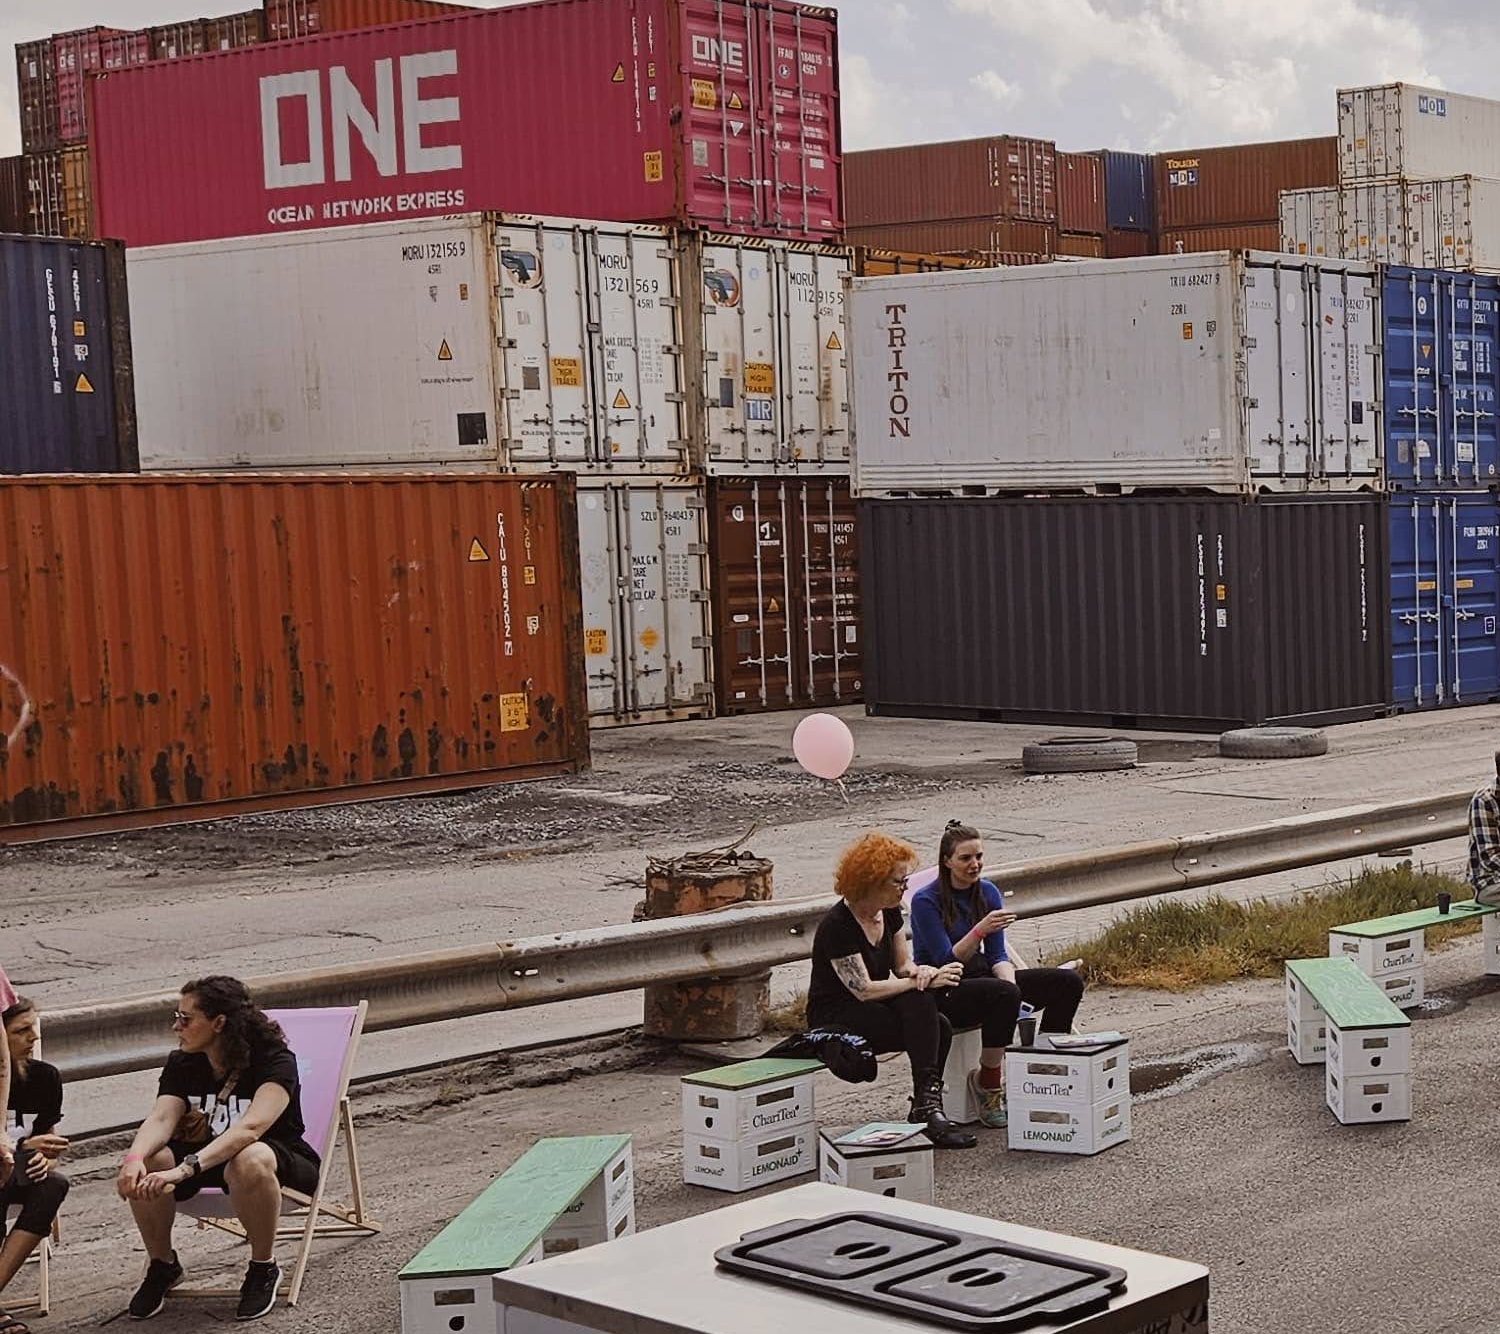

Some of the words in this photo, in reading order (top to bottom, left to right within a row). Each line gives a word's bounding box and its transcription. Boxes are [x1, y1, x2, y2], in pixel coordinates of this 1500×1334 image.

[692, 35, 743, 67] ONE
[1419, 96, 1446, 116] MOL
[260, 49, 463, 189] ONE
[267, 203, 315, 224] OCEAN
[322, 195, 393, 219] NETWORK
[396, 189, 465, 210] EXPRESS
[600, 253, 628, 270] MORU
[789, 272, 815, 287] MORU
[744, 362, 773, 372] CAUTION
[885, 304, 911, 438] TRITON
[746, 400, 771, 420] TIR
[497, 512, 508, 562] CAIU
[633, 579, 645, 589] NET
[1022, 1082, 1074, 1097] ChariTea
[752, 1104, 800, 1129] ChariTea
